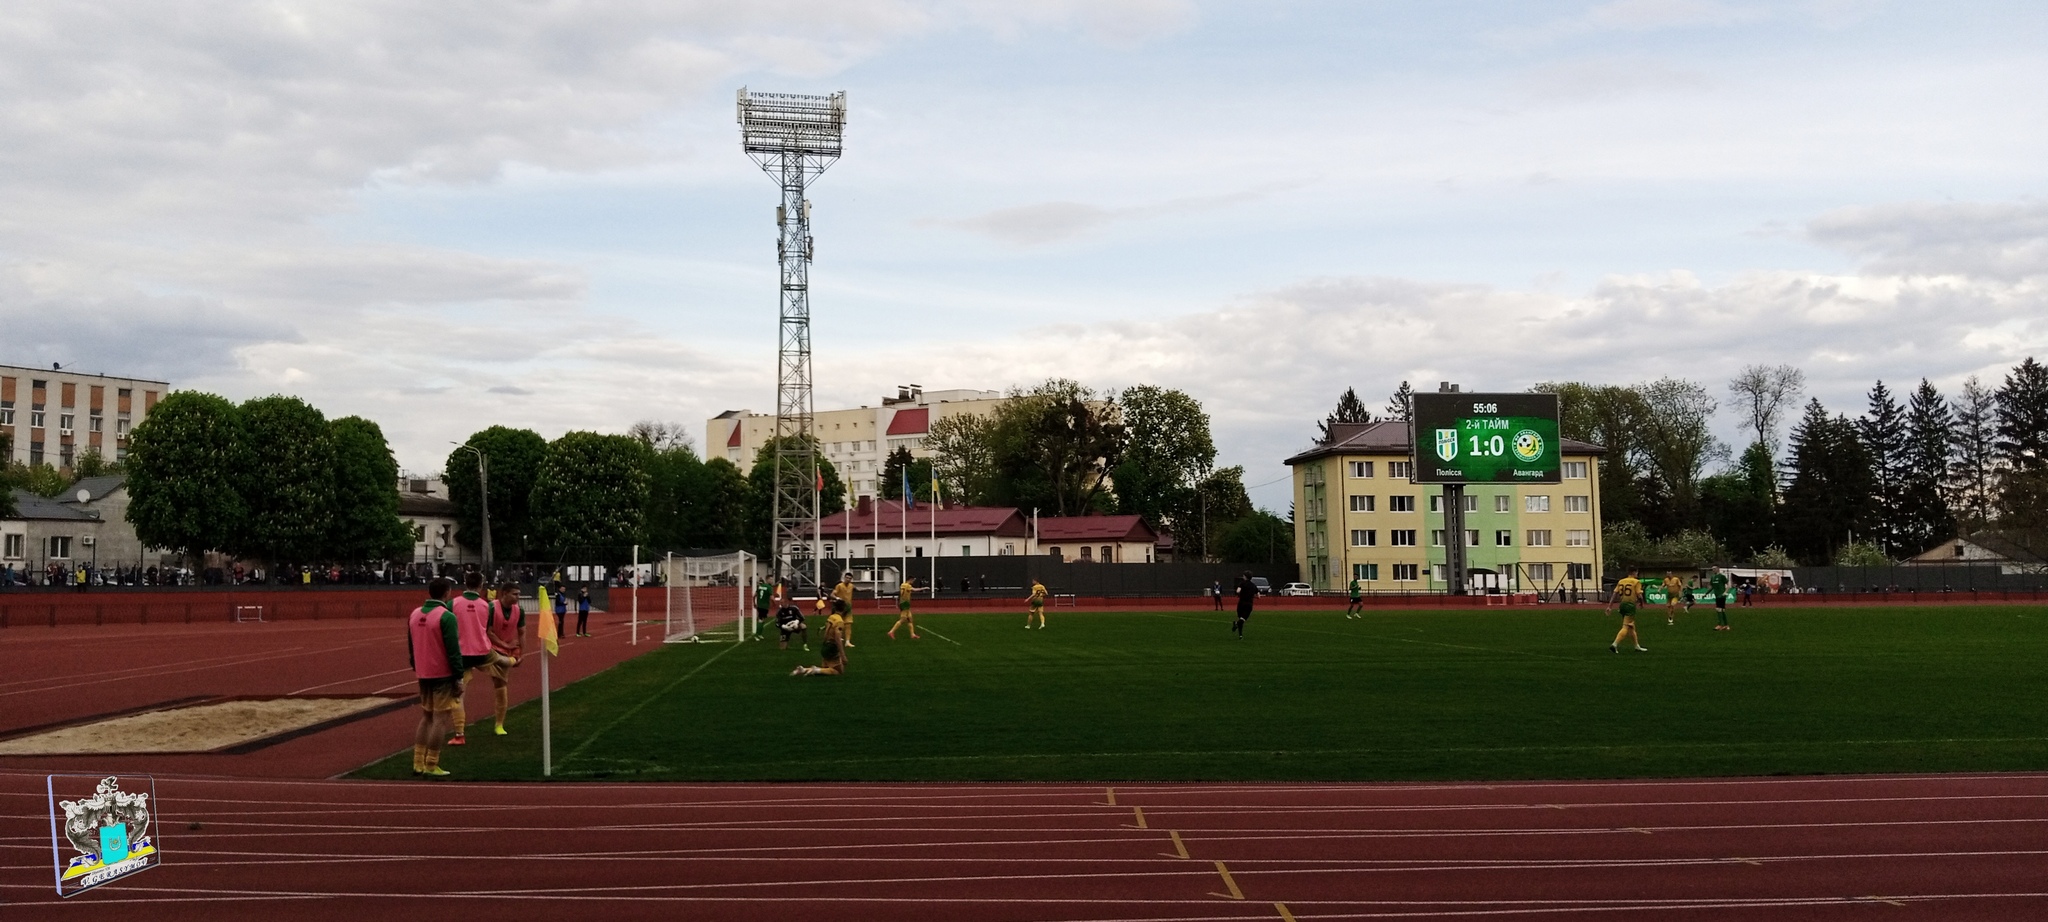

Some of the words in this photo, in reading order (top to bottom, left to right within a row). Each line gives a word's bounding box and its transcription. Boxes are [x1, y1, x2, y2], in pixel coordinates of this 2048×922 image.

[1473, 403, 1498, 413] 55:06
[1466, 420, 1480, 430] 2-й
[1482, 418, 1509, 430] ТАЙМ
[1469, 435, 1505, 456] 1:0
[1436, 469, 1462, 477] Полісся
[1513, 469, 1544, 478] Авангард
[1618, 584, 1632, 597] 36
